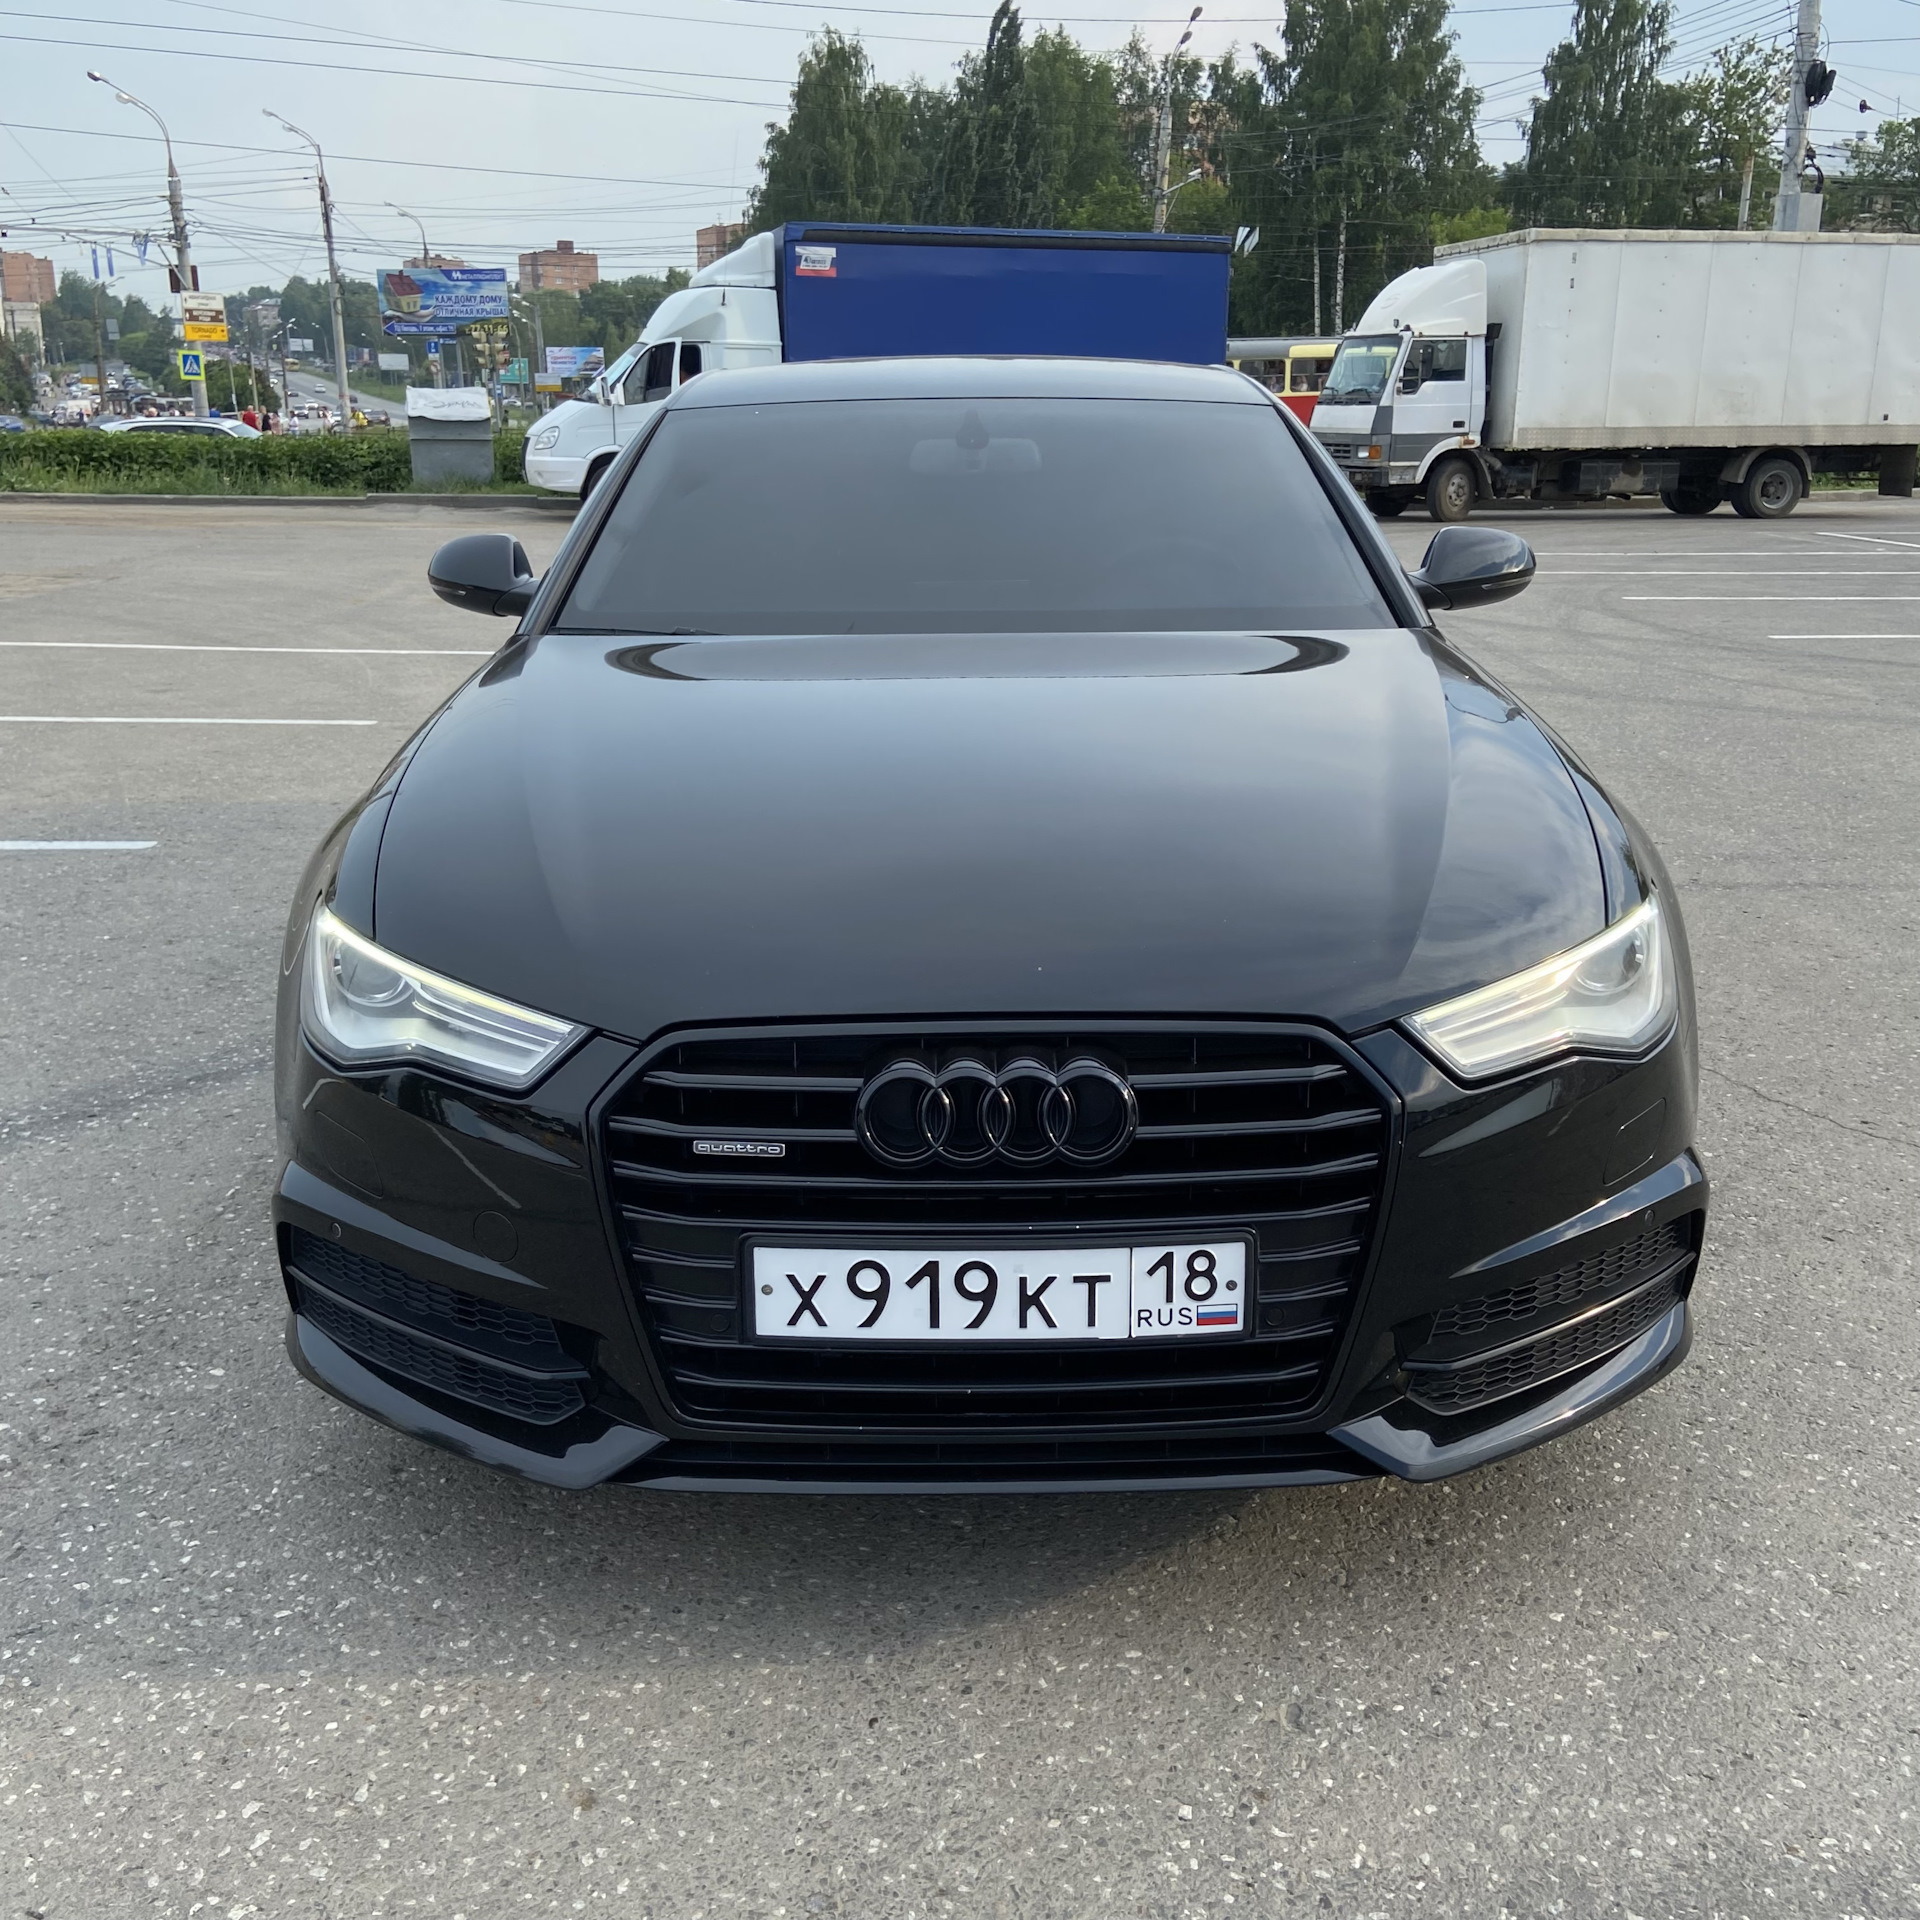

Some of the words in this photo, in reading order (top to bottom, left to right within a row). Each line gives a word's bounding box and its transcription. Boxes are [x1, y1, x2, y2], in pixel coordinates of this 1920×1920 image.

[435, 295, 477, 304] КАЖДОМУ
[479, 295, 503, 305] ДОМУ
[435, 307, 474, 316] ОТЛИЧНАЯ
[476, 307, 507, 316] КРЫША!
[697, 1143, 781, 1154] quattro
[1146, 1249, 1218, 1304] 18
[1137, 1306, 1193, 1328] RUS
